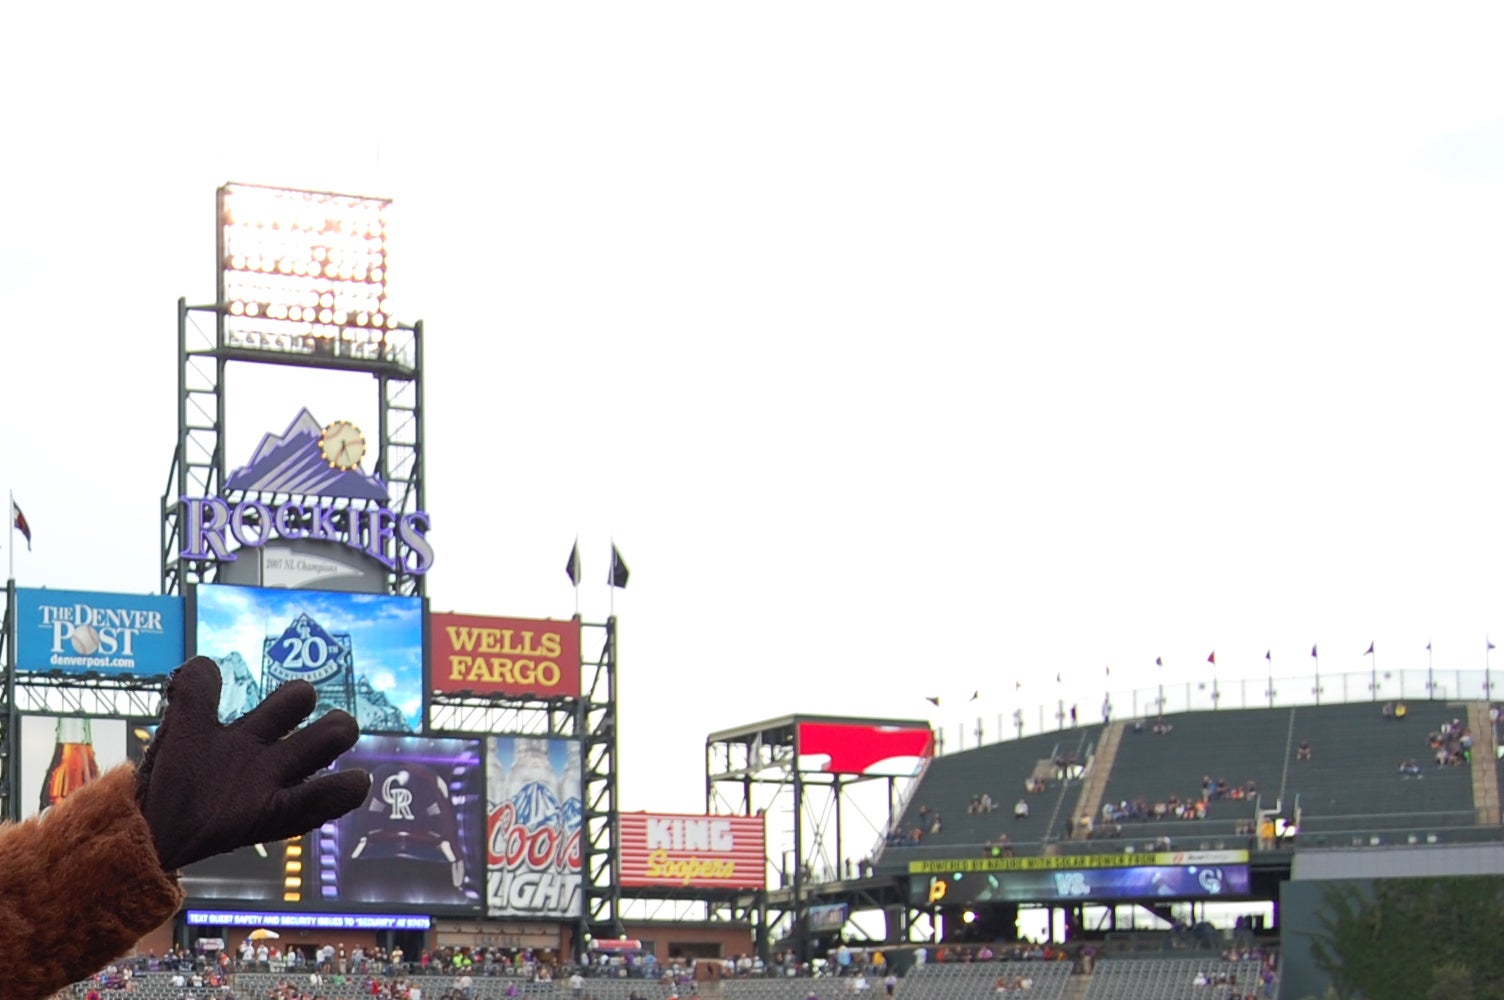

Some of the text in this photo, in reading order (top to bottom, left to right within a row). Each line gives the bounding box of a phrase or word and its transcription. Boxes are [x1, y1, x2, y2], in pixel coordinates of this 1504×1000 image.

[180, 495, 434, 575] ROCKIES
[297, 560, 338, 574] Champions
[39, 604, 163, 630] THE DENVER
[51, 620, 139, 656] POST
[446, 626, 562, 658] WELLS
[50, 654, 136, 669] denverpost.com
[449, 655, 561, 687] FARGO
[487, 801, 583, 871] Coors
[646, 818, 734, 851] KING
[646, 849, 735, 885] Soopers
[487, 872, 582, 911] LIGHT
[189, 914, 208, 924] TEXT
[234, 915, 263, 925] SAFETY
[263, 916, 279, 925] AND
[280, 916, 316, 927] SECURITY
